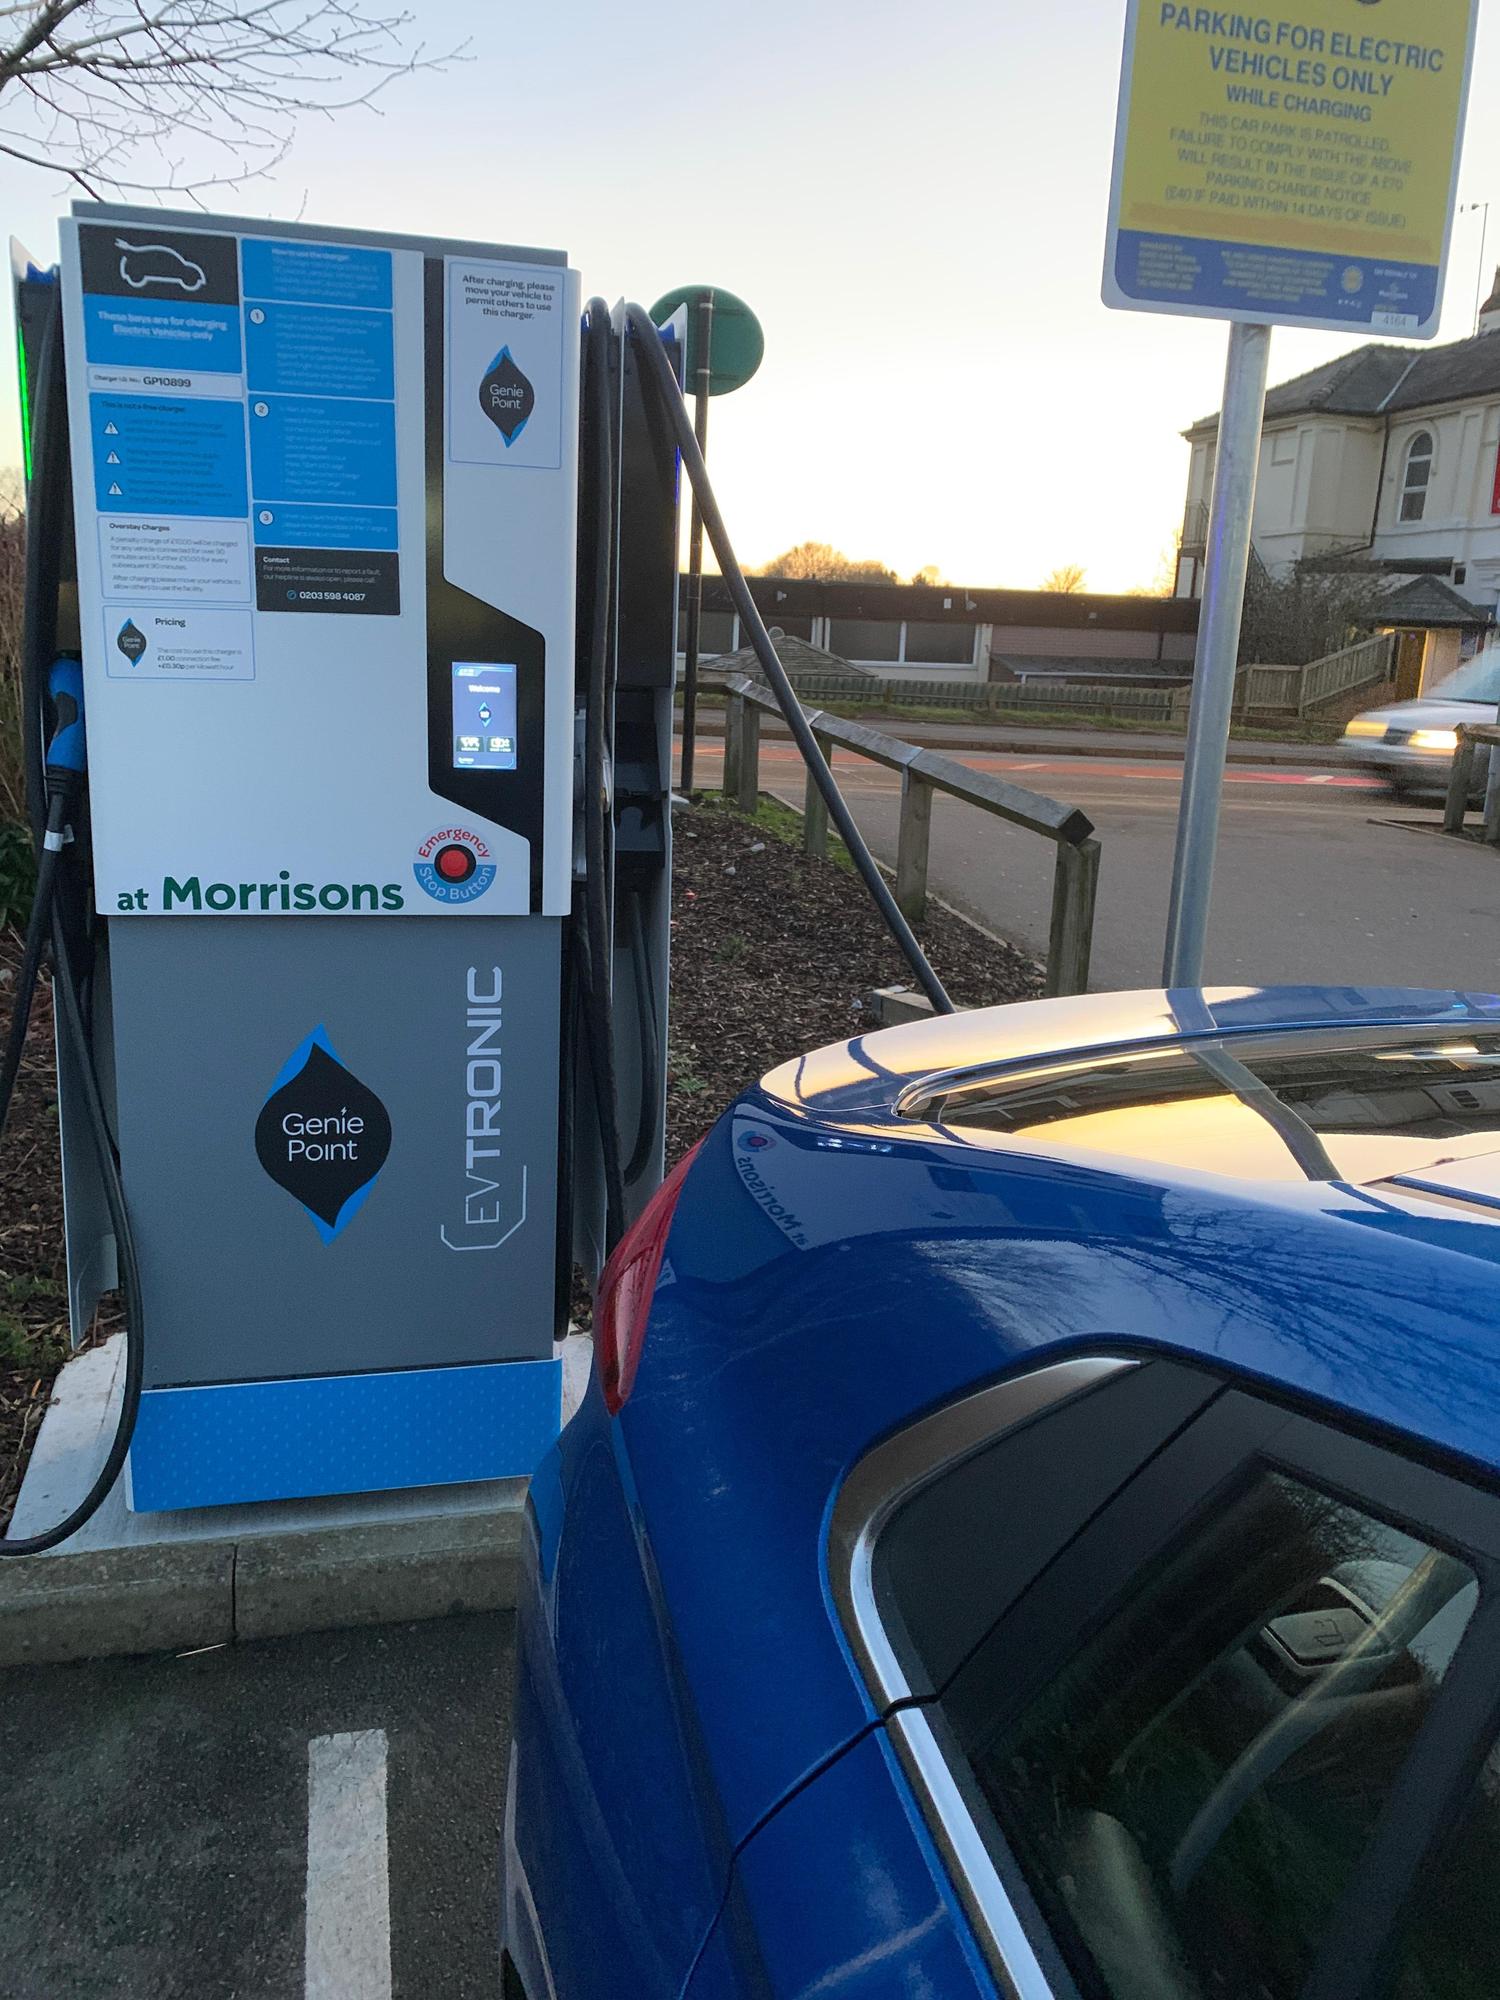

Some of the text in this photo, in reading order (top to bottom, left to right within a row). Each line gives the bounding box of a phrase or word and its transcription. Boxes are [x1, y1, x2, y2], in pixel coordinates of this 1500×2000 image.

[1160, 2, 1444, 72] PARKING FOR ELECTRIC
[1209, 45, 1394, 96] VEHICLES ONLY
[1226, 83, 1372, 122] WHILE CHARGING
[1200, 111, 1228, 130] THIS
[1230, 116, 1260, 133] CAR
[1261, 120, 1297, 138] PARK
[1300, 126, 1311, 142] IS
[1169, 127, 1411, 174] FAILURE TO COMPLY WITH THE ABOVE
[1177, 147, 1207, 165] WILL
[1212, 152, 1262, 172] RESULT
[1265, 159, 1279, 175] IN
[1284, 162, 1306, 178] THE
[1310, 166, 1346, 183] ISSUE
[1350, 171, 1368, 186] OF
[1370, 175, 1379, 188] A
[1205, 170, 1371, 205] PARKING CHARGE NOTICE
[1194, 187, 1206, 201] IF
[1210, 189, 1240, 207] PAID
[1243, 194, 1288, 213] WITHIN
[1293, 201, 1305, 214] 14
[1308, 203, 1342, 220] DAYS
[1345, 207, 1362, 221] OF
[462, 274, 485, 284] After
[526, 281, 556, 292] please
[465, 286, 552, 302] move your vehicle to
[465, 296, 552, 312] permit others to use
[482, 307, 499, 317] this
[170, 315, 185, 326] for
[185, 318, 228, 332] charging
[142, 375, 192, 388] GP10899
[489, 383, 524, 398] Genie
[491, 396, 521, 409] Point
[108, 522, 170, 533] Overstay Charges
[262, 556, 290, 564] Contact
[299, 591, 366, 601] 0203 598 4087
[155, 617, 186, 628] Pricing
[418, 828, 490, 858] Emergency
[117, 870, 405, 911] at Morrisons
[420, 866, 491, 900] Stop Button
[466, 966, 502, 1225] EVTRONIC
[282, 1106, 365, 1137] Genie
[287, 1138, 359, 1162] Point
